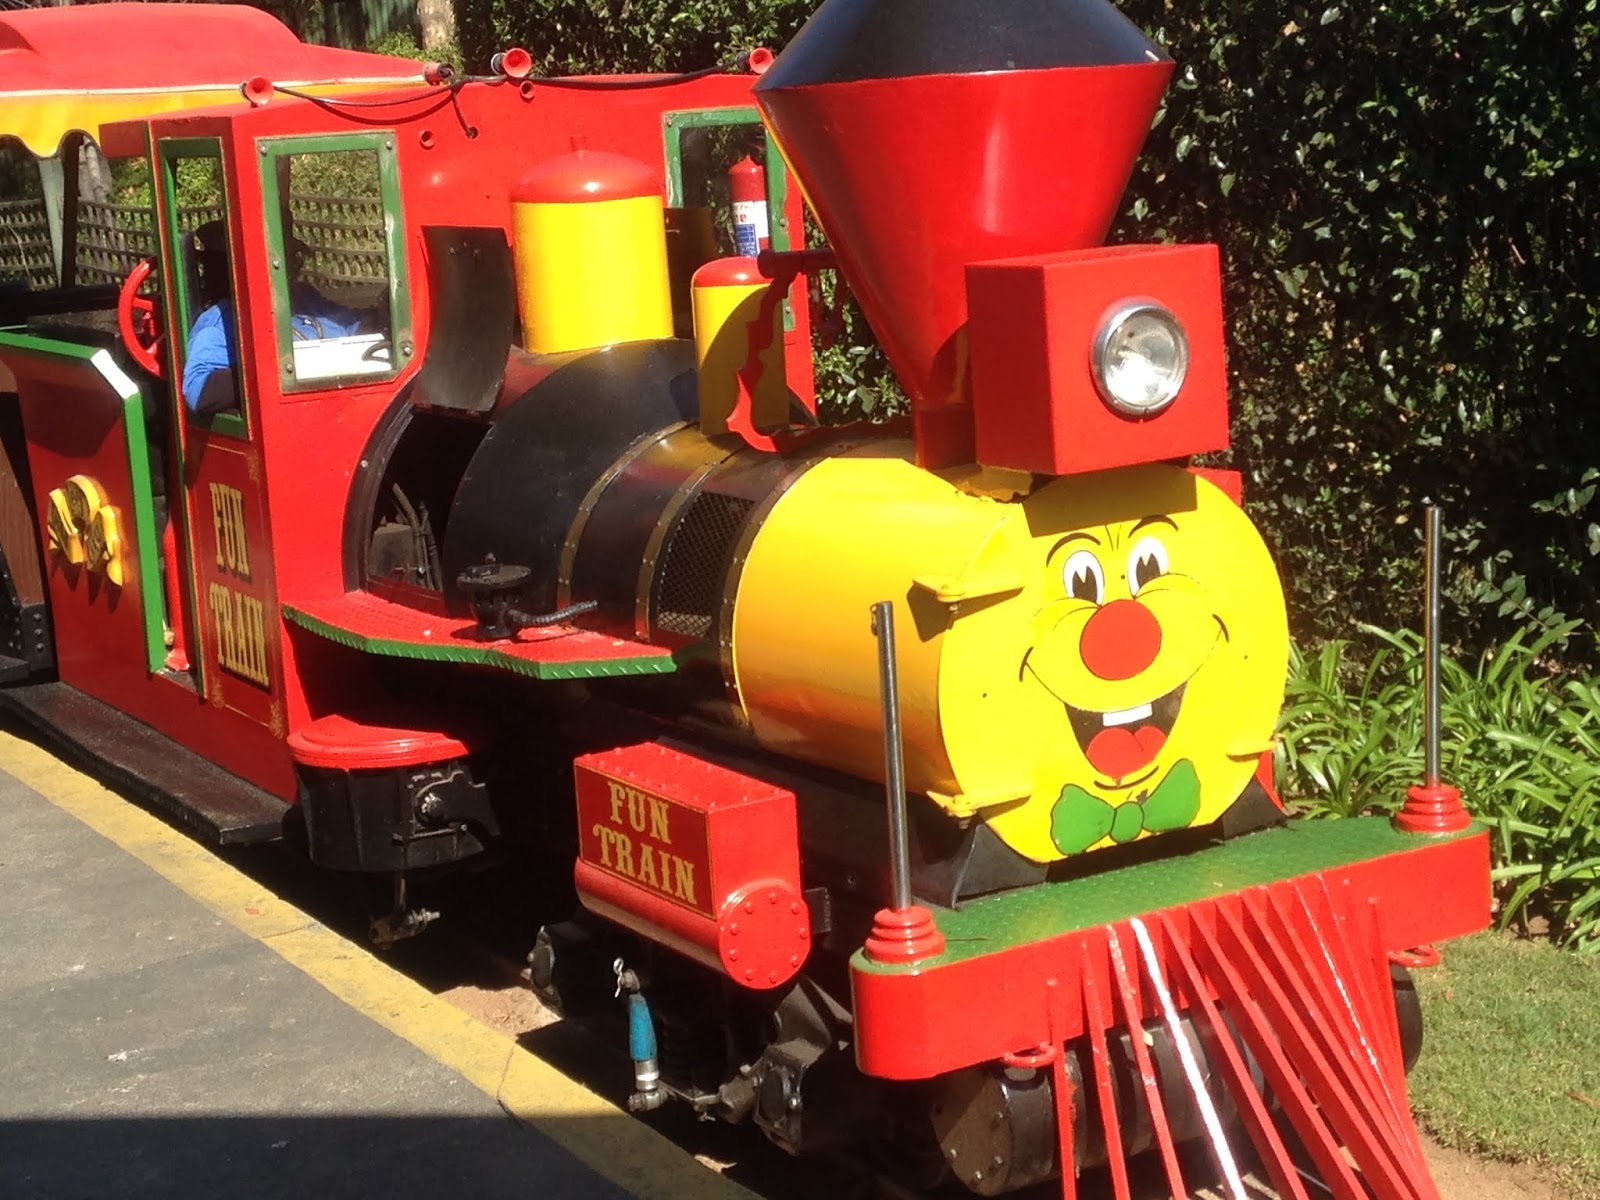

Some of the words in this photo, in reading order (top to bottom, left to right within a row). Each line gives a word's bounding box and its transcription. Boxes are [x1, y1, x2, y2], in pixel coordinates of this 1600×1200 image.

[209, 482, 250, 577] FUN
[209, 582, 269, 687] TRAIN
[607, 781, 671, 844] FUN
[593, 824, 697, 905] TRAIN
